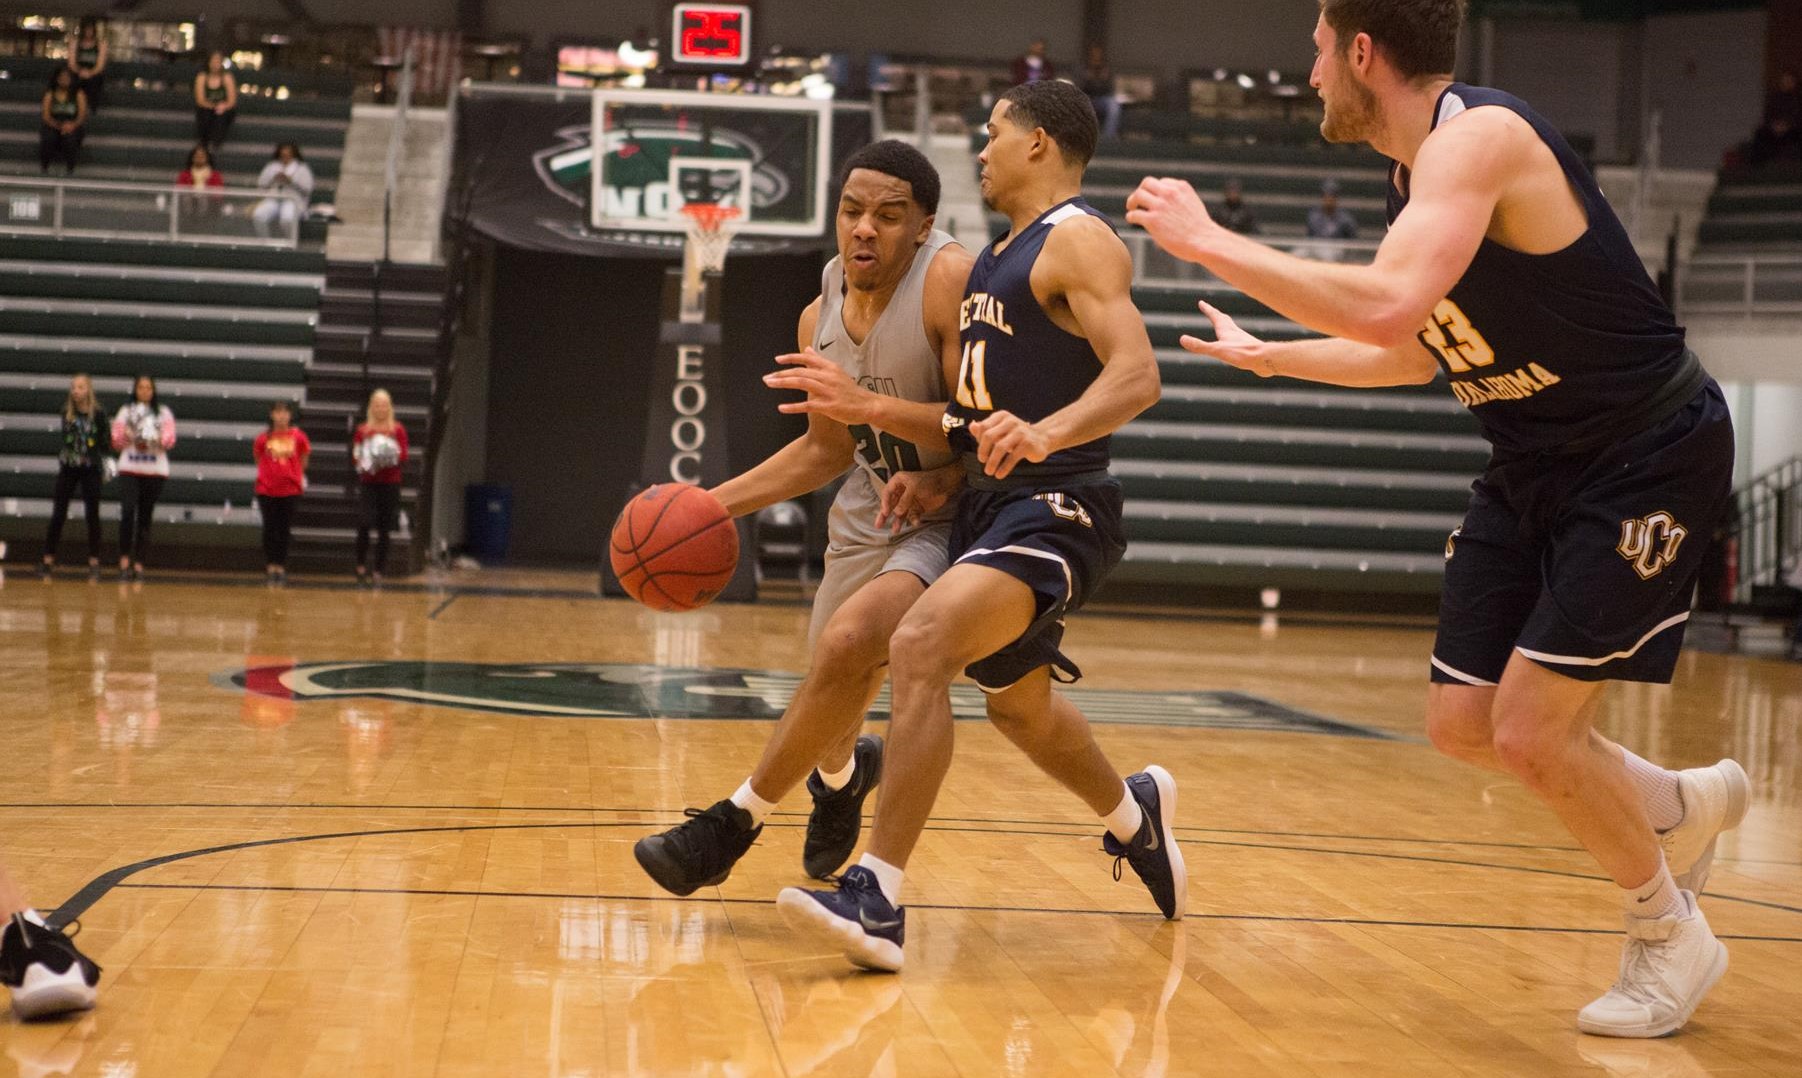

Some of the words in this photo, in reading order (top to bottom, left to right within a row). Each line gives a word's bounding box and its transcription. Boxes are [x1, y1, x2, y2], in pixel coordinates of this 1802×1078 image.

[682, 11, 741, 57] 25
[1421, 297, 1495, 373] 23
[956, 339, 993, 410] 11
[1616, 510, 1689, 581] UCO
